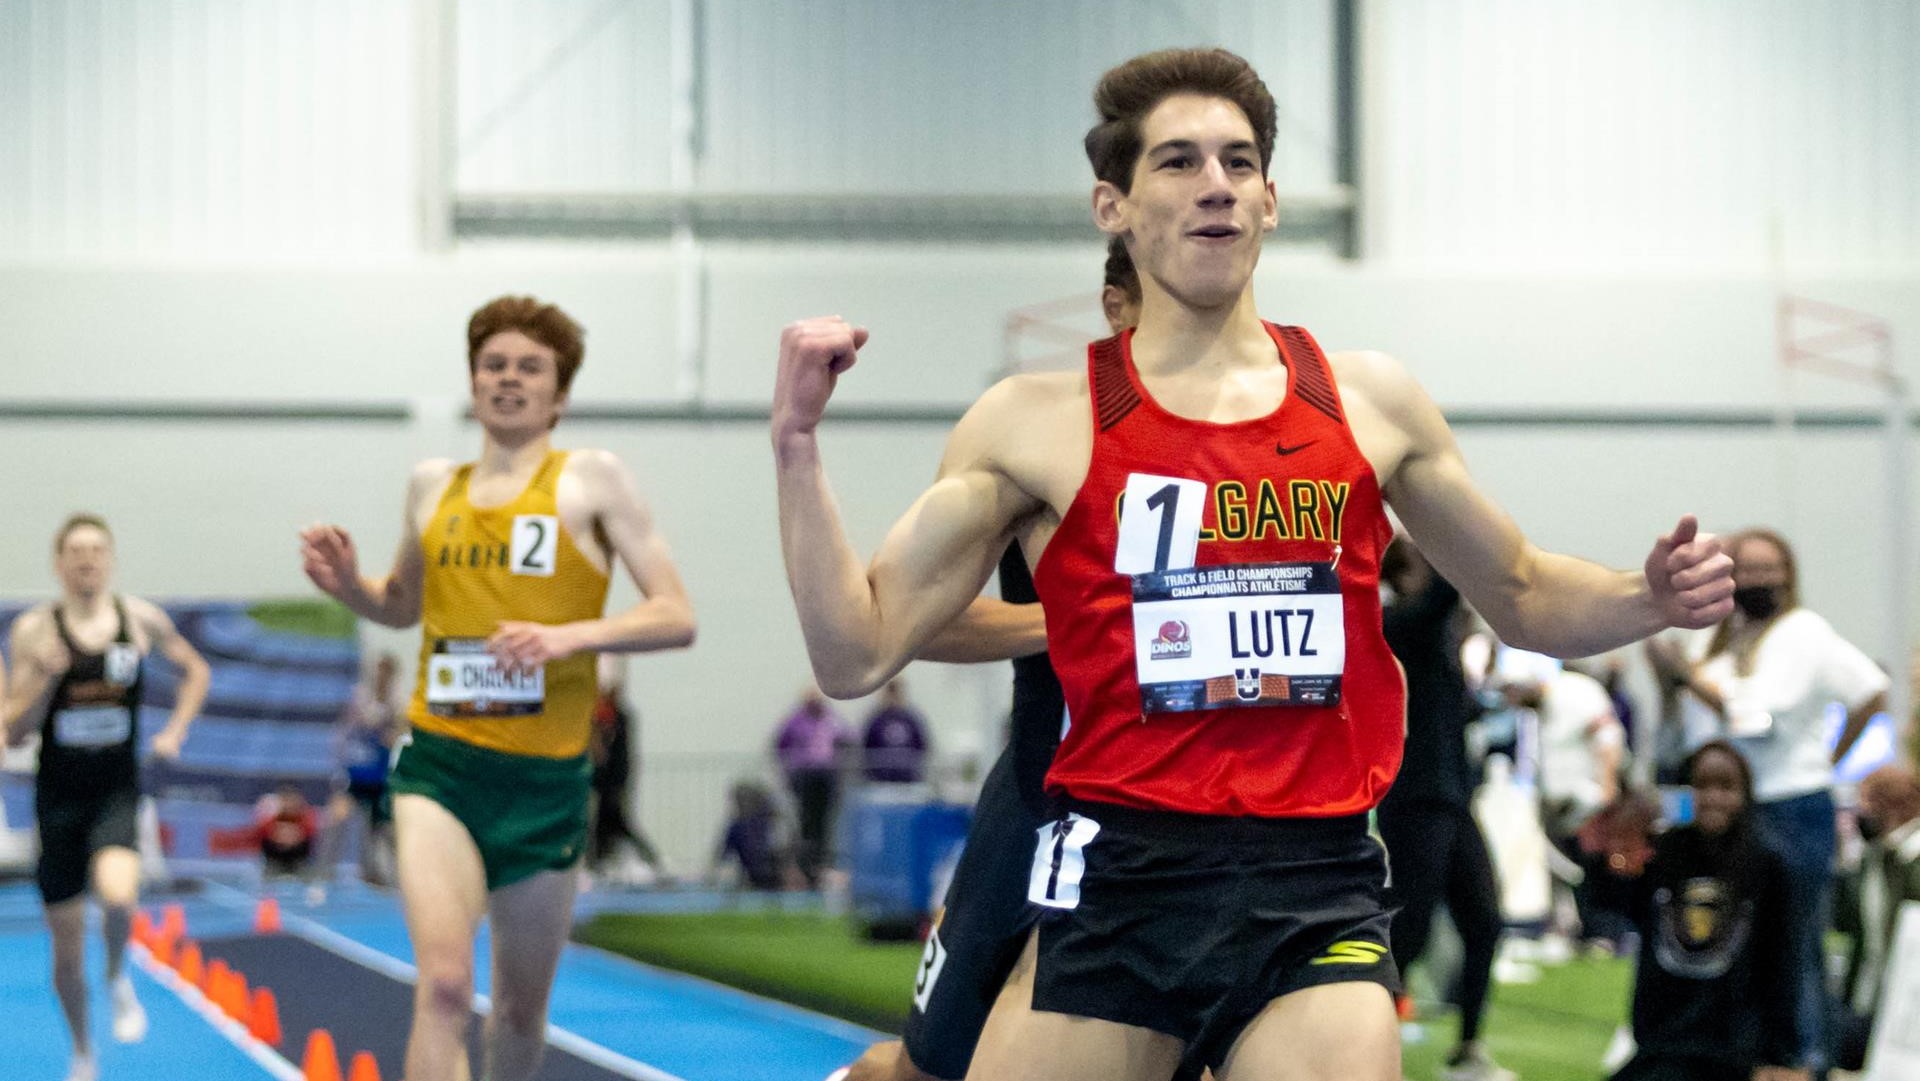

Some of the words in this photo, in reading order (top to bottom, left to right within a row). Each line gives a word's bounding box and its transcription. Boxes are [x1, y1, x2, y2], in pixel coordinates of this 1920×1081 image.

[1116, 479, 1350, 543] GARY
[1146, 483, 1180, 573] 1
[522, 521, 545, 568] 2
[1164, 572, 1197, 587] TRACK
[1208, 568, 1235, 582] FIELD
[1236, 567, 1313, 581] CHAMPIONSHIPS
[1171, 582, 1249, 598] CHAMPIONNATS
[1250, 578, 1307, 592] ATHLÉTISME
[1151, 640, 1191, 655] DINOS
[1228, 609, 1318, 659] LUTZ
